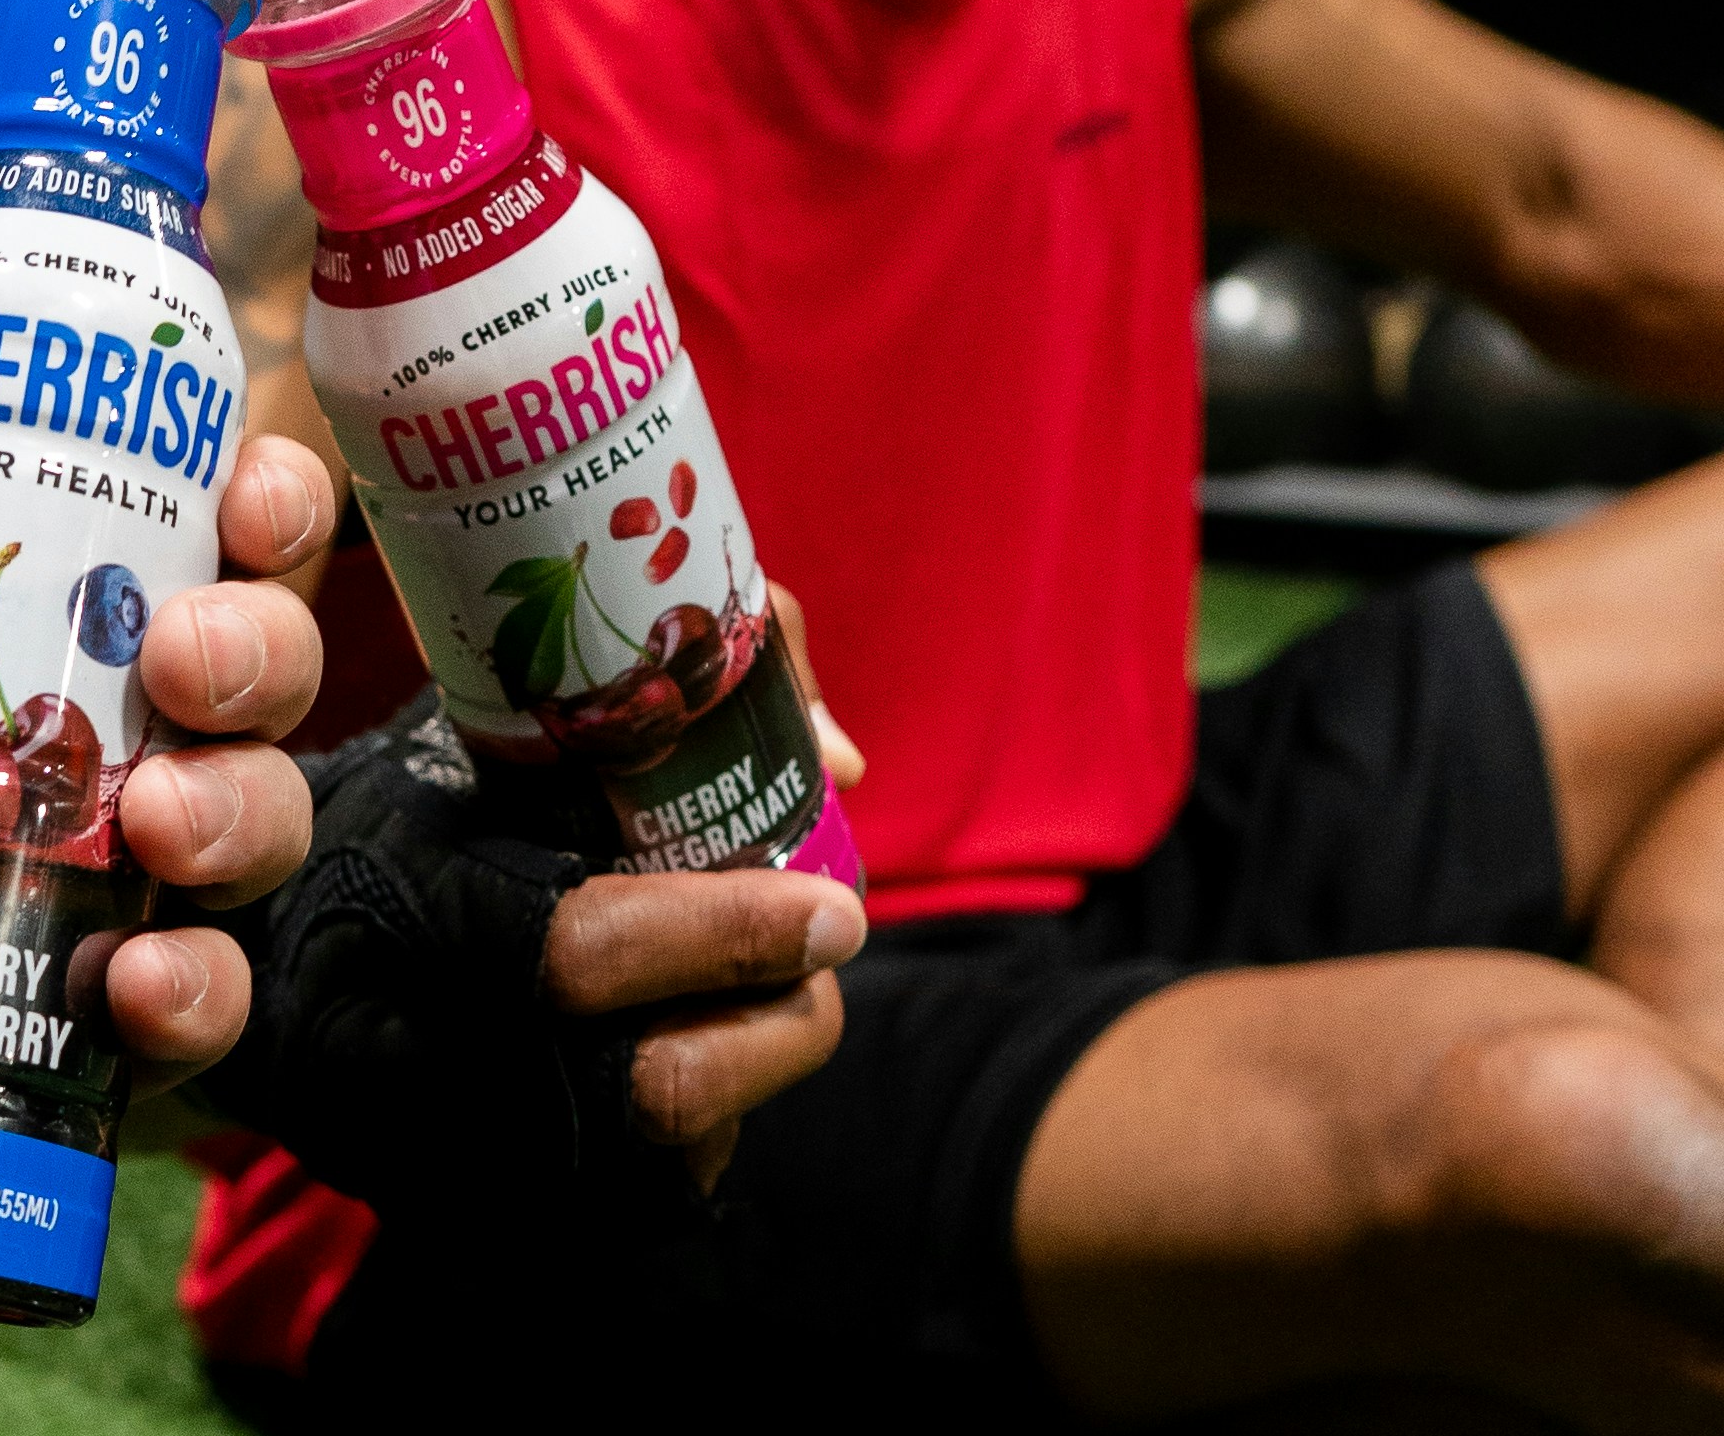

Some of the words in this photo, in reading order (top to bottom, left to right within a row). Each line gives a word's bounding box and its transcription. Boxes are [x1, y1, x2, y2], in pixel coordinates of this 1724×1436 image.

[85, 20, 144, 94] 96
[102, 91, 161, 136] BOTTLE
[379, 148, 432, 188] EVERY
[439, 109, 473, 183] BOTTLE
[392, 78, 447, 148] 96
[27, 166, 111, 203] ADDED
[120, 183, 184, 235] SUAR
[382, 244, 410, 278] NO
[415, 216, 484, 270] ADDED
[481, 177, 545, 236] SUGAR
[24, 252, 137, 288] CHERRY
[150, 286, 213, 342] JUICE
[392, 345, 455, 389] 100%
[461, 293, 552, 352] CHERRY
[561, 264, 617, 303] JUICE
[380, 283, 674, 493] CHERRISH
[36, 457, 179, 529] HEALTH
[454, 484, 552, 530] YOUR
[563, 405, 673, 498] HEALTH
[633, 755, 755, 845] CHERRY
